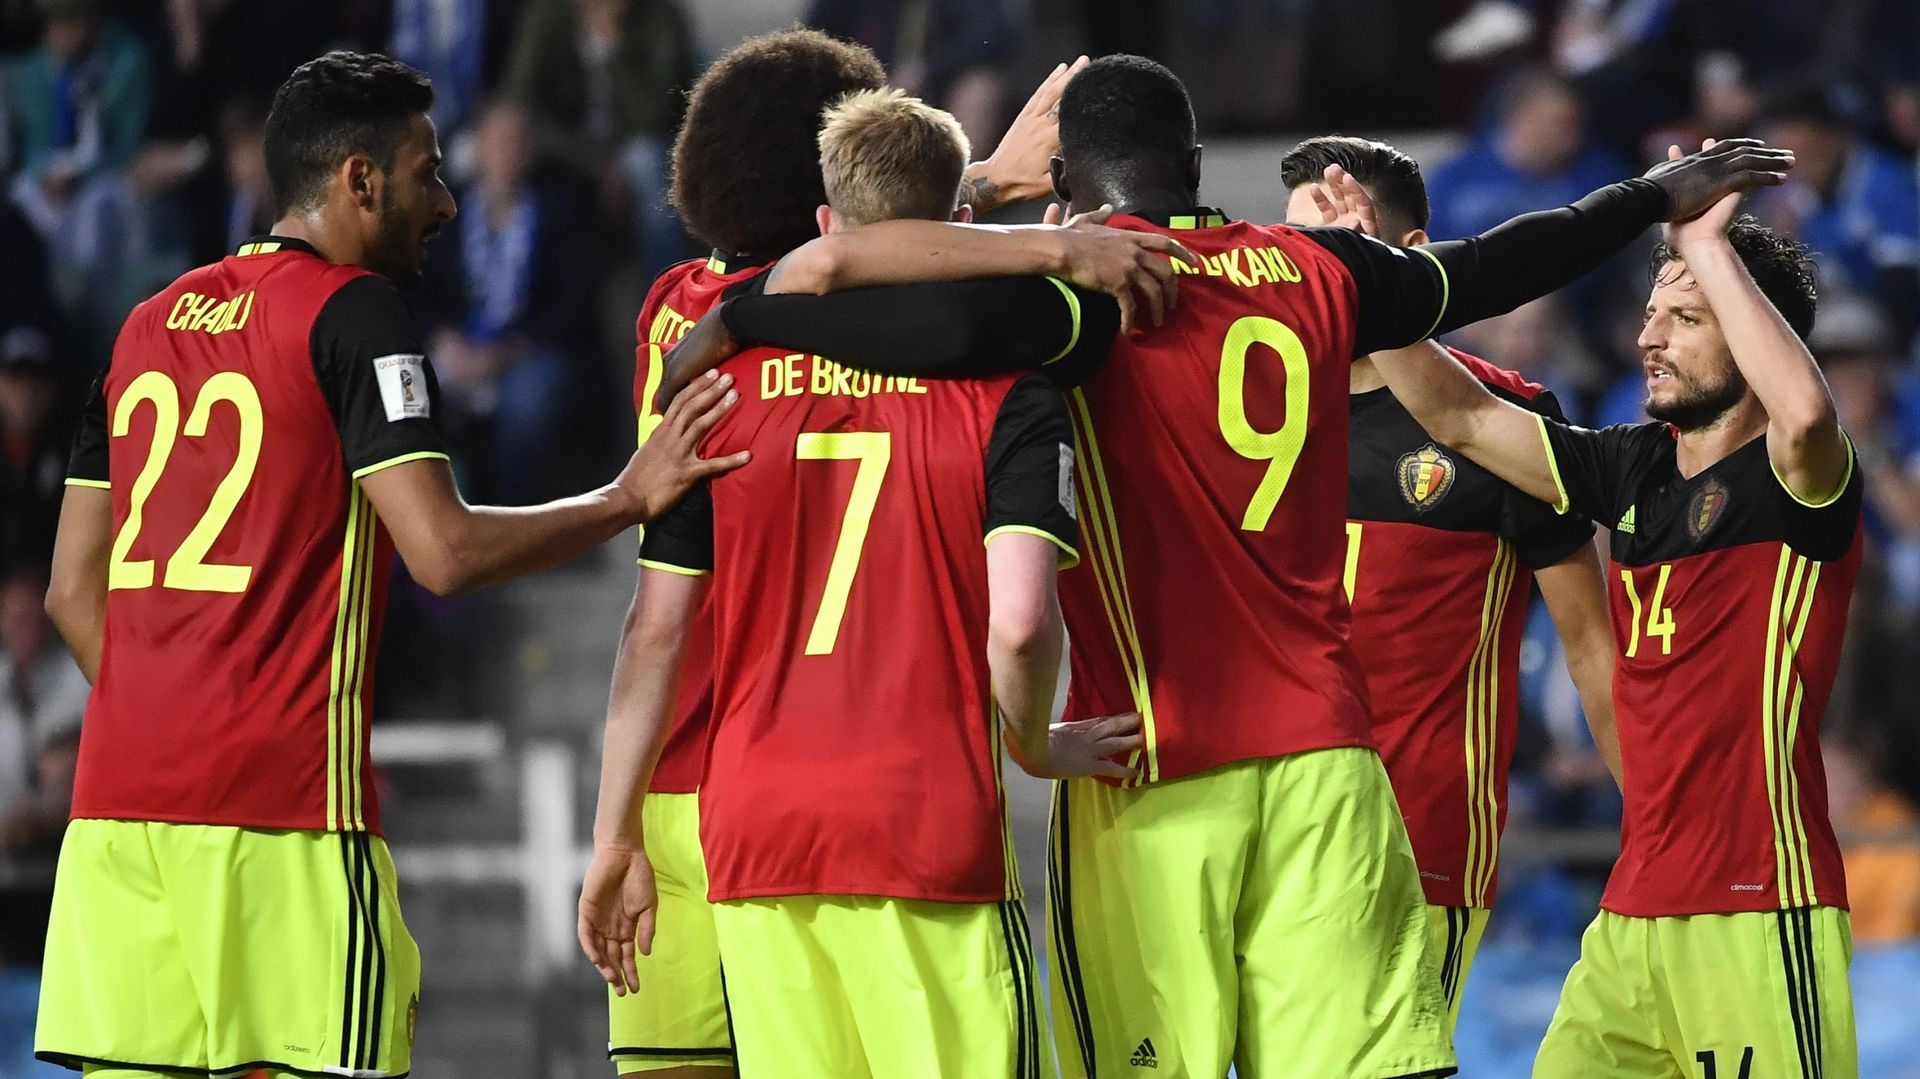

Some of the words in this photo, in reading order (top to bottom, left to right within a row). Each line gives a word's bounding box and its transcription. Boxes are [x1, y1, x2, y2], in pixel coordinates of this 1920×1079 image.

[761, 354, 804, 400] DE
[1218, 316, 1310, 532] 9
[108, 370, 264, 593] 22
[796, 431, 891, 656] 7
[1621, 564, 1676, 658] 14
[1130, 1055, 1158, 1069] adidas
